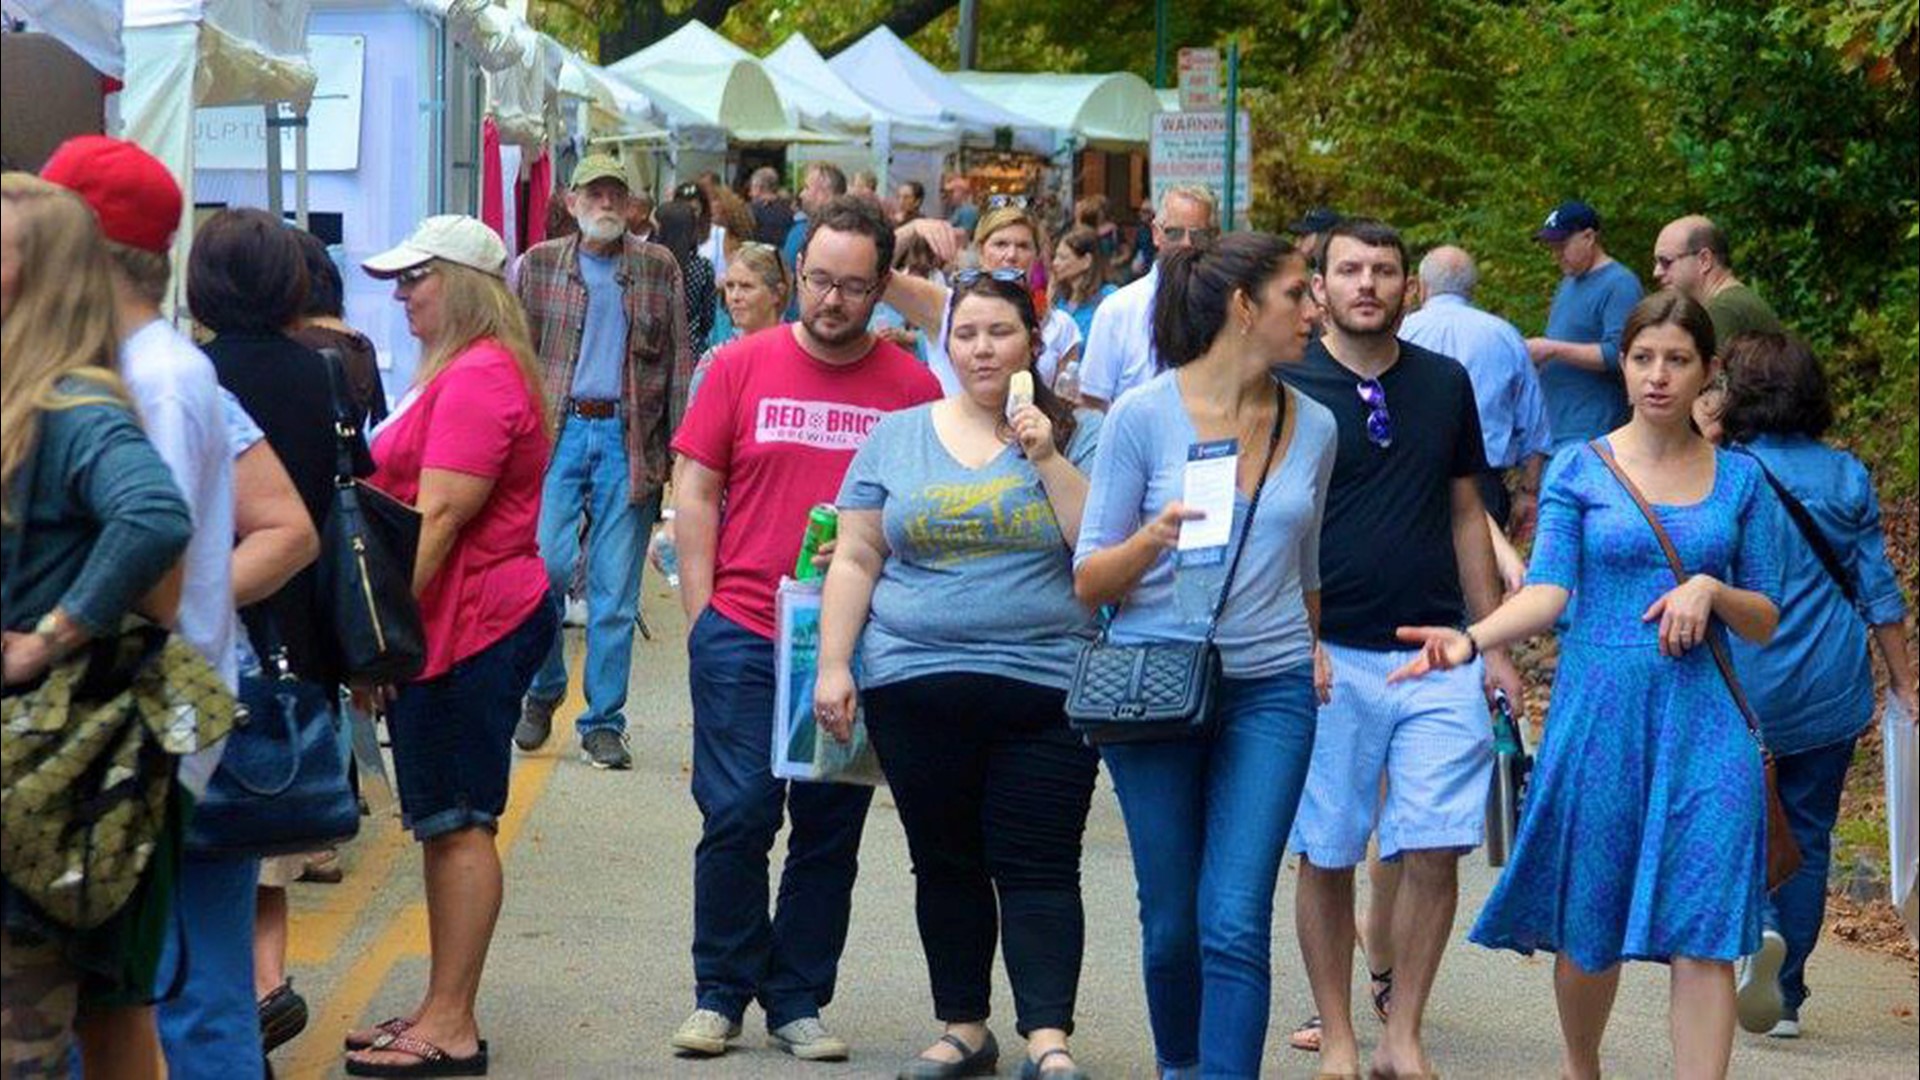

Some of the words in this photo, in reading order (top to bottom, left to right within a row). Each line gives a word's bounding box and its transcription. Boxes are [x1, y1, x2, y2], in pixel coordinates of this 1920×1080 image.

[1160, 115, 1228, 132] WARNIN
[764, 405, 806, 429] RED
[777, 429, 847, 444] BREWING
